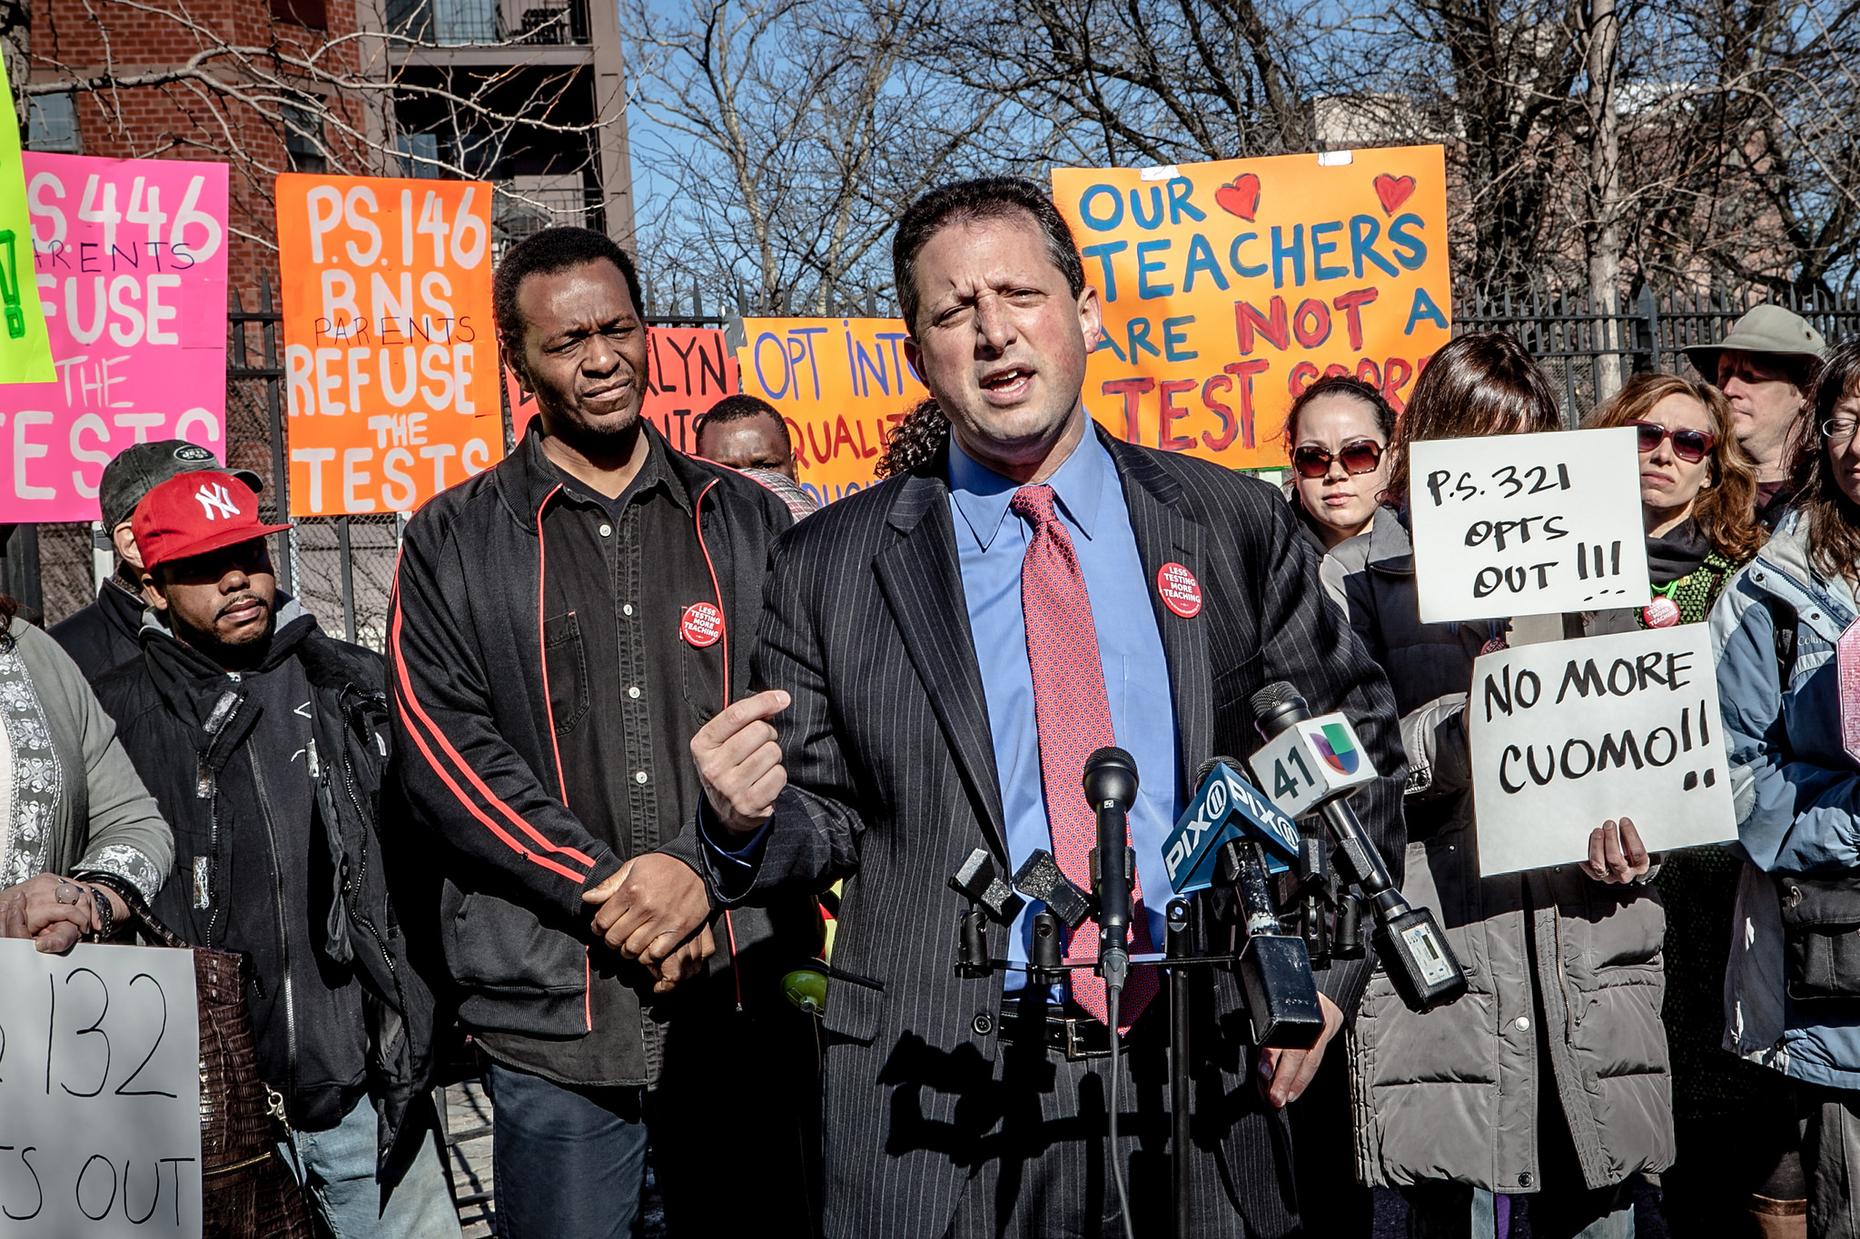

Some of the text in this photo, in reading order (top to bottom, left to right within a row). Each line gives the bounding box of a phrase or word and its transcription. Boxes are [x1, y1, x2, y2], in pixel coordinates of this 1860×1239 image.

[1078, 176, 1207, 232] OUR
[1082, 213, 1428, 303] TEACHERS
[321, 269, 456, 344] BNS
[1096, 287, 1450, 365] ARE NOT A
[314, 316, 476, 346] PARENTS
[56, 355, 135, 409] THE
[285, 344, 476, 418] REFUSE
[754, 327, 829, 401] OPT
[1101, 358, 1271, 452] TEST
[0, 407, 220, 500] EST
[368, 412, 428, 449] THE
[1427, 463, 1571, 507] P.S. 321
[1464, 515, 1569, 552] OPTS
[1164, 573, 1196, 587] TESTING
[1168, 566, 1188, 577] LESS
[1170, 582, 1193, 593] MORE
[1473, 561, 1559, 598] OUT
[690, 610, 721, 624] TESTING
[698, 606, 716, 616] LESS
[1164, 589, 1201, 603] TEACHING
[684, 621, 719, 637] TEACHING
[693, 618, 714, 629] MORE
[1485, 651, 1694, 723] NO MORE
[1273, 746, 1315, 799] 41
[46, 968, 178, 1098] 132
[76, 1154, 196, 1227] OUT
